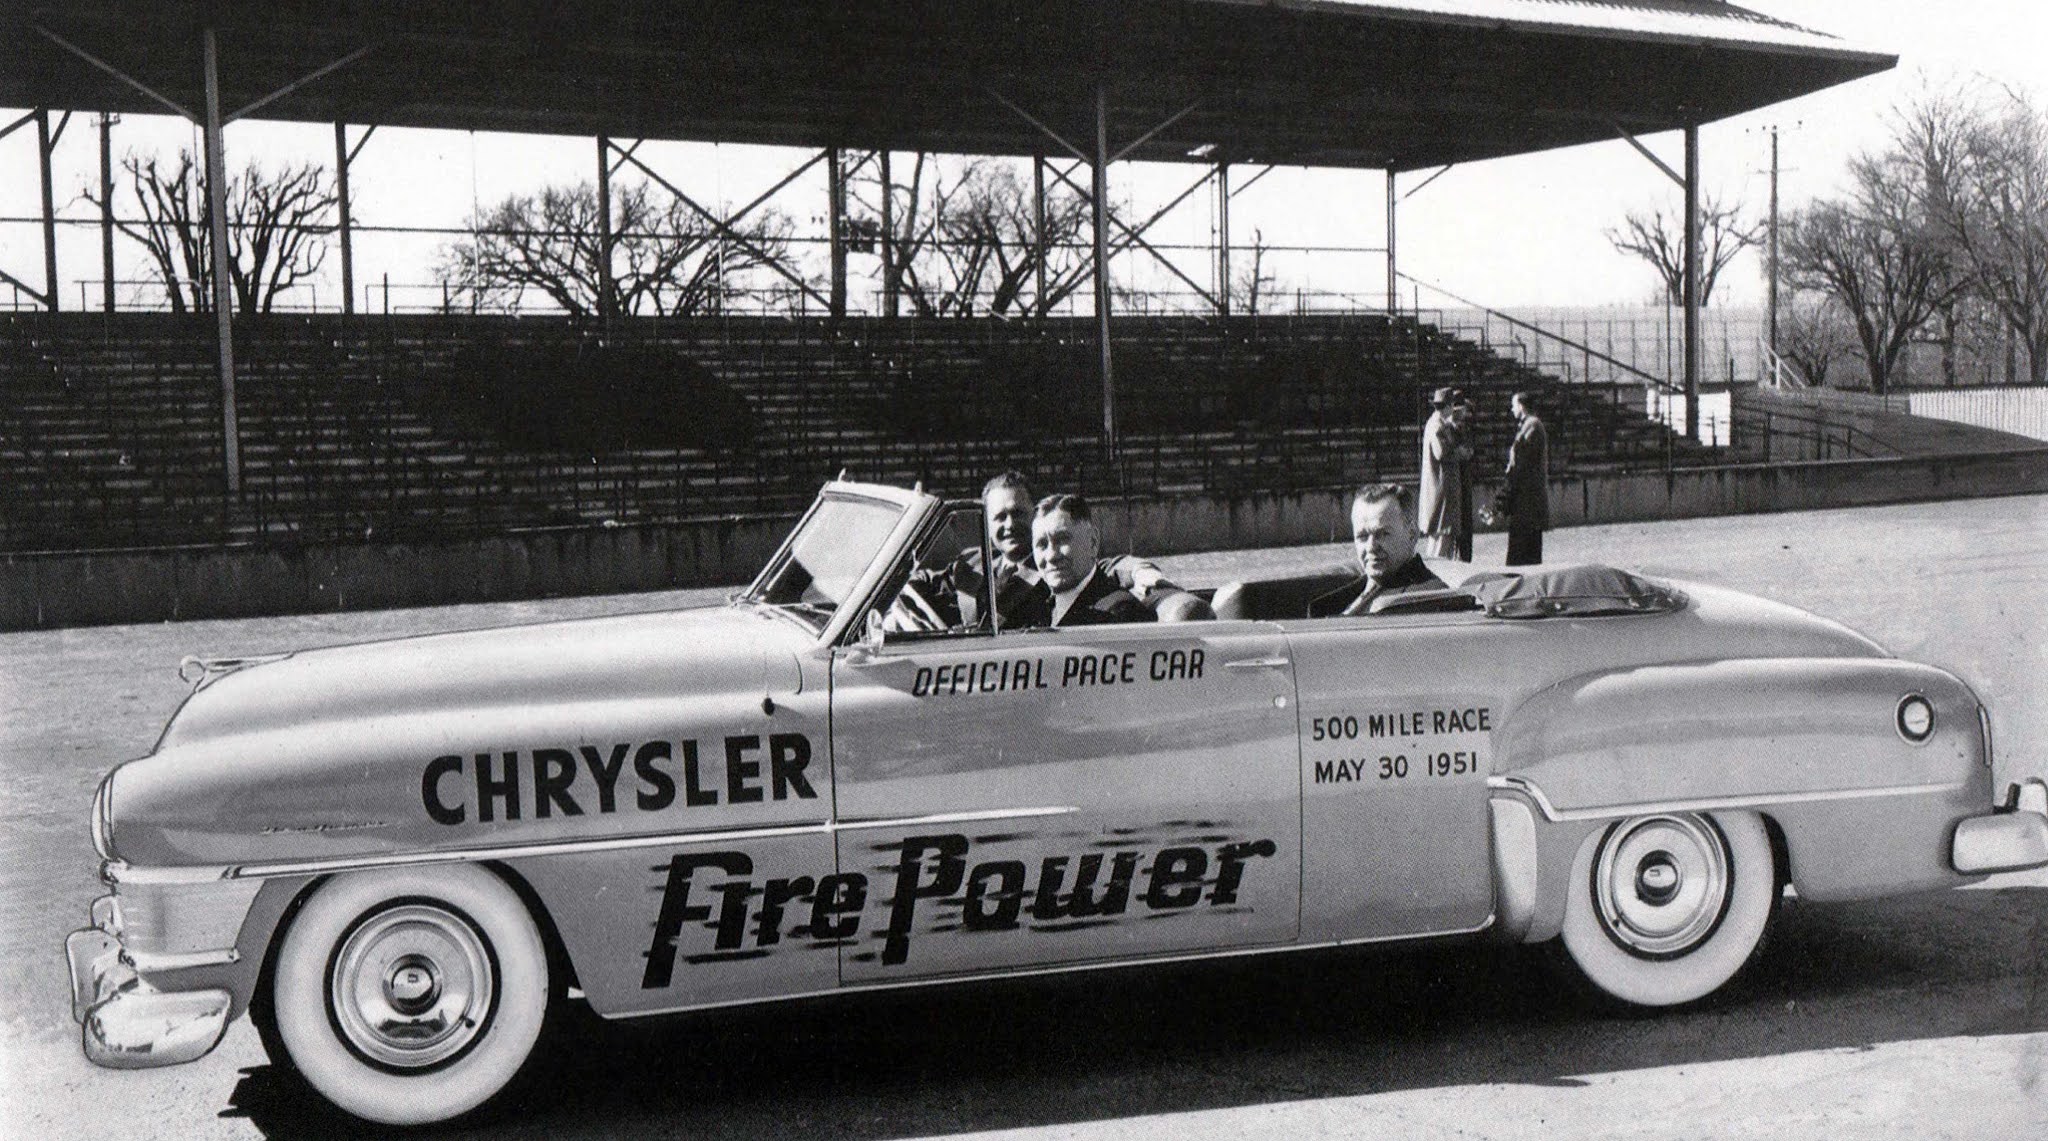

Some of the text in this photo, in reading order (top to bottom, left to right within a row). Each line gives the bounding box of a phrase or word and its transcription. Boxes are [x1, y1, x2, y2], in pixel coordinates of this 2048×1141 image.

[913, 649, 1206, 697] OFFICIAL PACE CAR
[1313, 708, 1491, 741] 500 MILE RACE
[421, 732, 818, 826] CHRYSLER
[1315, 752, 1477, 784] MAY 30 1951
[641, 833, 1277, 990] Fire Power
